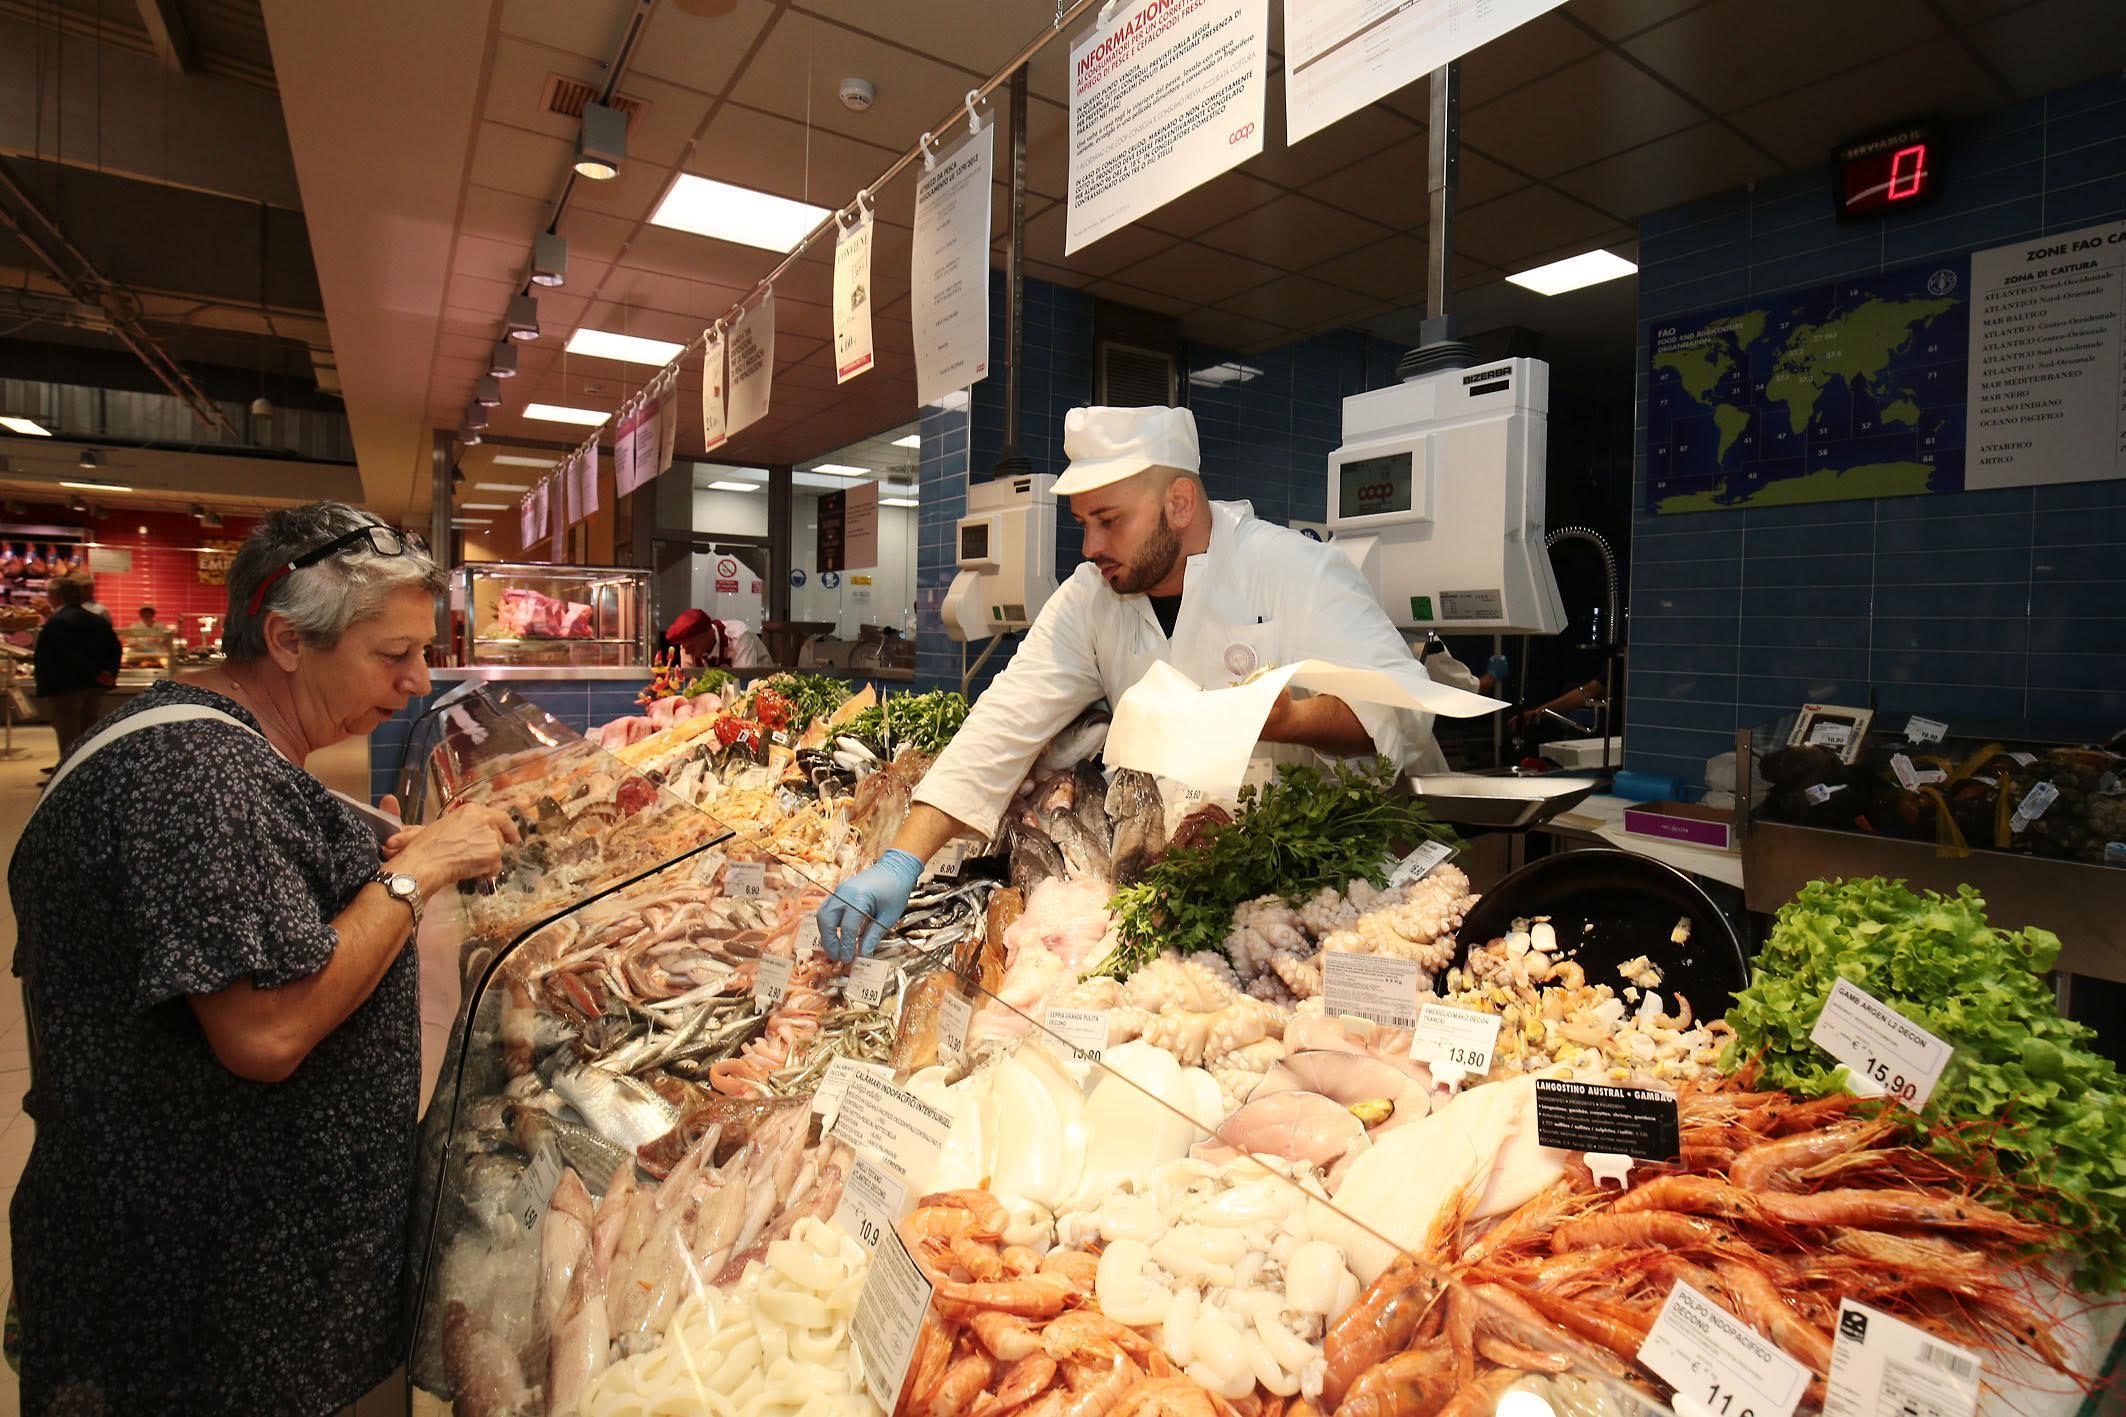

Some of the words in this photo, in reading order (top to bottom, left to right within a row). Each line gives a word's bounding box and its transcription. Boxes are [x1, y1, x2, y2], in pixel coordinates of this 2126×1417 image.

[1077, 72, 1101, 96] IMPIEGO
[1104, 66, 1109, 75] DI
[1112, 51, 1128, 69] PESCE
[1137, 13, 1178, 51] CEFALOPODI
[1085, 41, 1128, 81] CONSUMATORI
[1132, 30, 1142, 44] PER
[1146, 20, 1156, 33] UN
[1121, 65, 1147, 88] CONTROLLI
[1149, 48, 1171, 69] PREVISTI
[1173, 35, 1190, 52] DALLA
[1192, 21, 1209, 39] LEGGE
[1085, 100, 1108, 122] PREVENIRE
[1114, 80, 1137, 102] PROBLEMI
[1139, 66, 1157, 84] DOVUTI
[1202, 14, 1232, 41] PRESENZA
[1235, 7, 1241, 18] DI
[1083, 93, 1099, 109] QUESTO
[1102, 80, 1117, 95] PUNTO
[1119, 63, 1139, 83] VENDITA
[1075, 178, 1080, 186] IN
[1082, 169, 1094, 182] CASO
[1102, 149, 1126, 169] CONSUMO
[1149, 118, 1176, 140] MARINATO
[1186, 104, 1199, 117] NON
[1201, 70, 1252, 107] COMPLETAMENTE
[1077, 116, 1097, 136] PARASSITI
[1229, 122, 1255, 144] coop
[1076, 180, 1089, 194] COTTO
[1096, 161, 1121, 181] PRODOTTO
[1123, 152, 1134, 164] DEVE
[1136, 141, 1152, 156] ESSERE
[1155, 108, 1205, 145] PREVENTIVAMENTE
[1207, 84, 1244, 112] CONGELATO
[1085, 179, 1103, 195] ALMENO
[1113, 168, 1121, 177] ORE
[1151, 126, 1189, 155] CONGELATORE
[1192, 105, 1225, 130] DOMESTICO
[1075, 178, 1117, 208] CONTRASSEGNATO
[1119, 170, 1129, 182] CON
[1157, 144, 1172, 159] STELLE
[1889, 144, 1925, 200] 0
[2026, 243, 2067, 262] ZONE
[2072, 235, 2102, 253] FAO
[2003, 271, 2033, 285] ZONA
[2037, 268, 2048, 279] DI
[2050, 259, 2098, 276] CATTURA
[1984, 284, 2037, 302] ATLANTICO
[1983, 297, 2037, 315] ATLANTICO
[1982, 316, 2004, 327] MAR
[2005, 309, 2047, 323] BALTICO
[1658, 327, 1676, 338] FAO
[1658, 336, 1678, 346] FOOD
[1679, 332, 1695, 340] AND
[1982, 324, 2034, 340] ATLANTICO
[1982, 336, 2035, 352] ATLANTICO
[1982, 349, 2035, 364] ATLANTICO
[1463, 366, 1512, 385] BIZERBA
[1981, 362, 2034, 377] ATLANTICO
[1981, 379, 2001, 390] MAR
[2003, 369, 2082, 387] MEDITERRANEO
[1979, 403, 2018, 415] OCEANO
[2019, 397, 2062, 410] INDIANO
[1980, 392, 2001, 402] MAR
[2002, 389, 2029, 399] NERO
[1979, 416, 2018, 427] OCEANO
[2019, 411, 2063, 423] PACIFICO
[1978, 440, 2032, 453] ANTARTICO
[1978, 454, 2013, 465] ARTICO
[1358, 483, 1394, 502] coop
[1837, 986, 1861, 1005] GAMB
[1859, 1001, 1888, 1022] ARGEN
[1897, 1025, 1927, 1048] DECON
[1448, 1047, 1485, 1068] 13,80
[1537, 1081, 1585, 1094] LANGOSTINO
[1588, 1086, 1625, 1098] AUSTRAL
[1865, 1057, 1917, 1101] 15,90
[859, 1218, 880, 1247] 10,9
[1671, 1301, 1711, 1333] DECONG
[1676, 1291, 1710, 1318] POLPO
[1706, 1311, 1775, 1364] INDOPACIFICO
